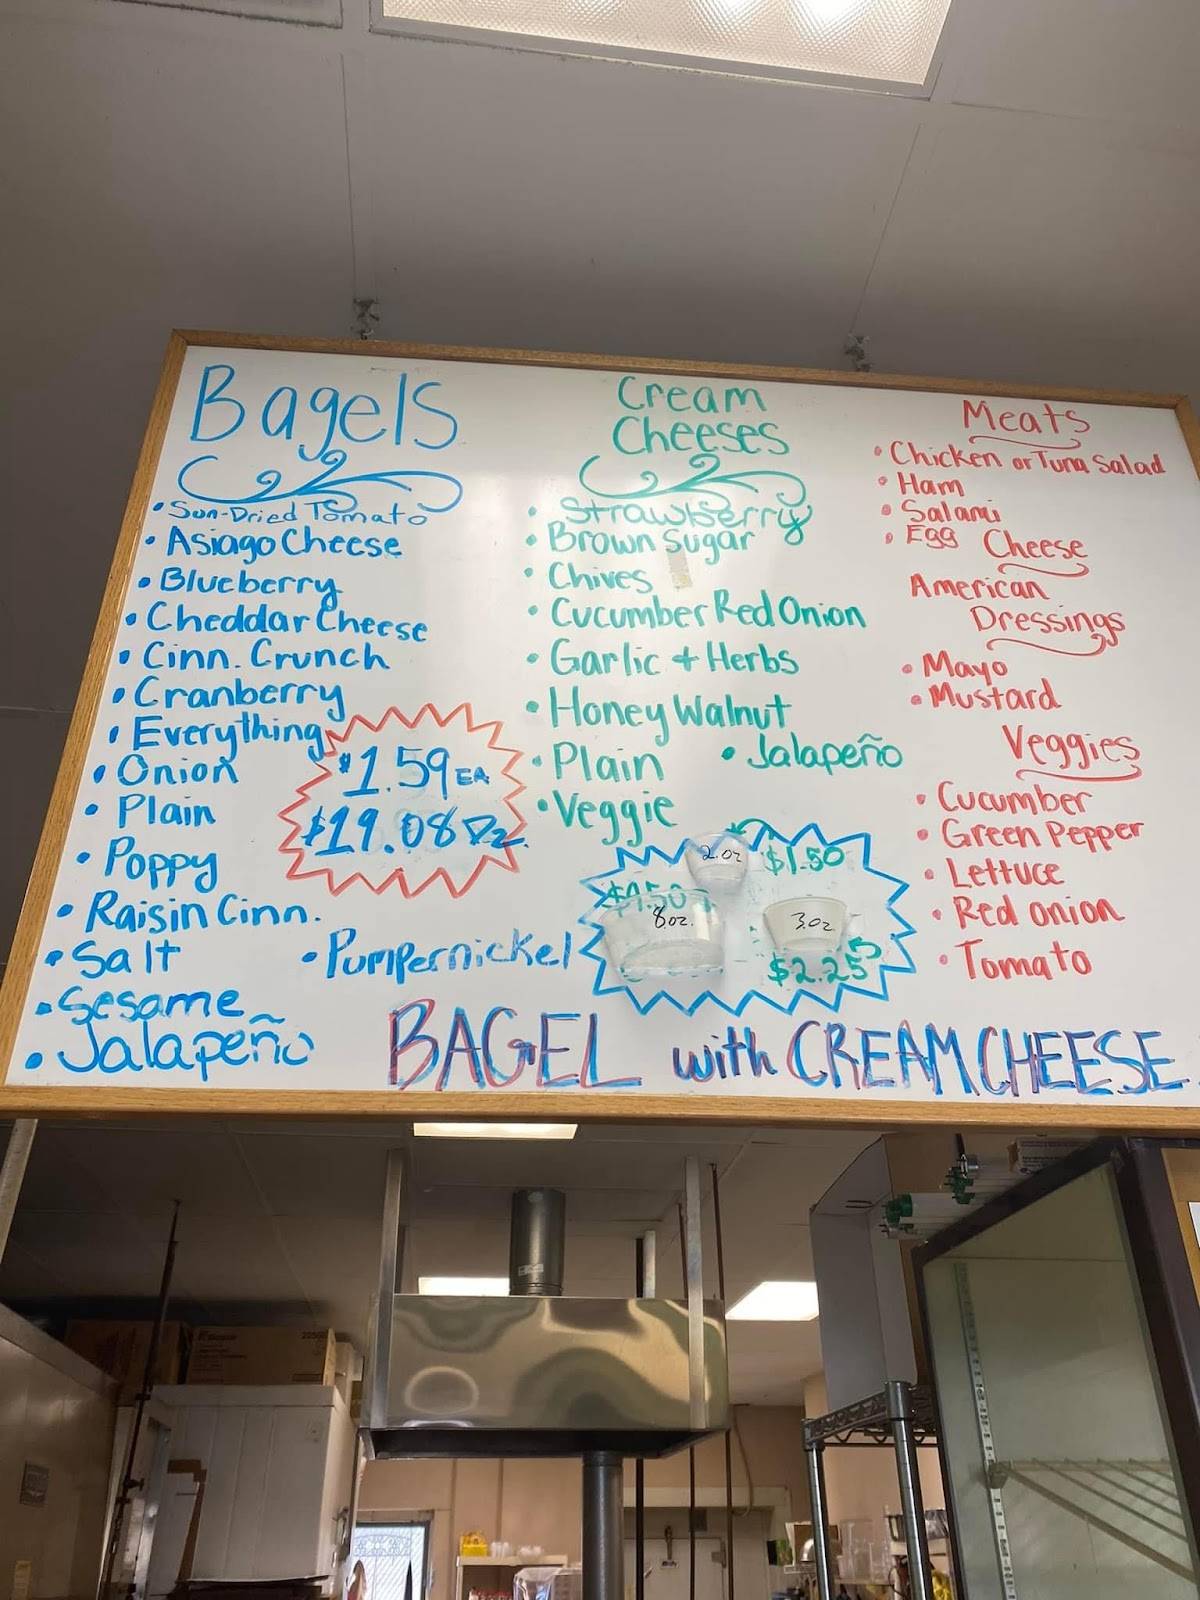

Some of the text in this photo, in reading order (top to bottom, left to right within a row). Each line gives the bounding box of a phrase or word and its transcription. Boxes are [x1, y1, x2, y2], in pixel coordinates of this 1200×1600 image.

[189, 364, 459, 461] Bagels
[617, 375, 767, 414] Cream
[612, 415, 791, 456] Cheeses
[962, 399, 1091, 434] Meats
[889, 440, 1167, 476] Chicken or Tuna Salad
[896, 471, 965, 497] Ham
[167, 499, 429, 527] Sun-Dried Tomato
[559, 496, 814, 546] Strawberry
[900, 499, 1002, 523] Salami
[166, 525, 403, 564] Asiago Cheese
[548, 520, 756, 565] Brown Sugar
[905, 524, 959, 549] Egg
[982, 528, 1089, 559] Cheese
[160, 566, 343, 612] Blueberry
[548, 561, 654, 594] Chives
[909, 572, 1051, 600] American
[146, 601, 429, 643] Cheddar Cheese
[551, 588, 866, 629] Cucumber Red Onion
[969, 604, 1127, 647] Dressings
[143, 637, 391, 670] Cinn. Crunch
[550, 637, 661, 677] Garlic
[706, 640, 800, 675] Herbs
[922, 649, 1009, 686] Mayo
[133, 675, 347, 723] Cranberry
[928, 677, 1063, 710] Mustard
[549, 685, 793, 748] Honey Walnut
[132, 712, 326, 762] Everything
[747, 731, 903, 776] Jalapeño
[1001, 724, 1141, 770] Veggies
[117, 754, 240, 786] Onion
[338, 745, 490, 801] $1.59 EA
[551, 740, 665, 784] Plain
[118, 794, 217, 829] Plain
[937, 780, 1093, 815] Cucumber
[301, 805, 459, 856] $19.08
[551, 790, 676, 847] Veggie
[941, 818, 1145, 853] Green Pepper
[104, 835, 218, 892] Poppy
[764, 845, 846, 877] $1.50
[945, 857, 1065, 889] Lettuce
[85, 890, 322, 936] Raisin Cinn.
[953, 895, 1019, 930] Red
[72, 940, 181, 980] Salt
[327, 928, 572, 986] Pumpernickel
[767, 952, 869, 988] $2.25
[954, 938, 1093, 981] Tomato
[57, 985, 245, 1026] Sesame
[58, 1013, 316, 1082] Jalapeño
[388, 998, 1191, 1098] BAGEL with CREAM CHEESE
